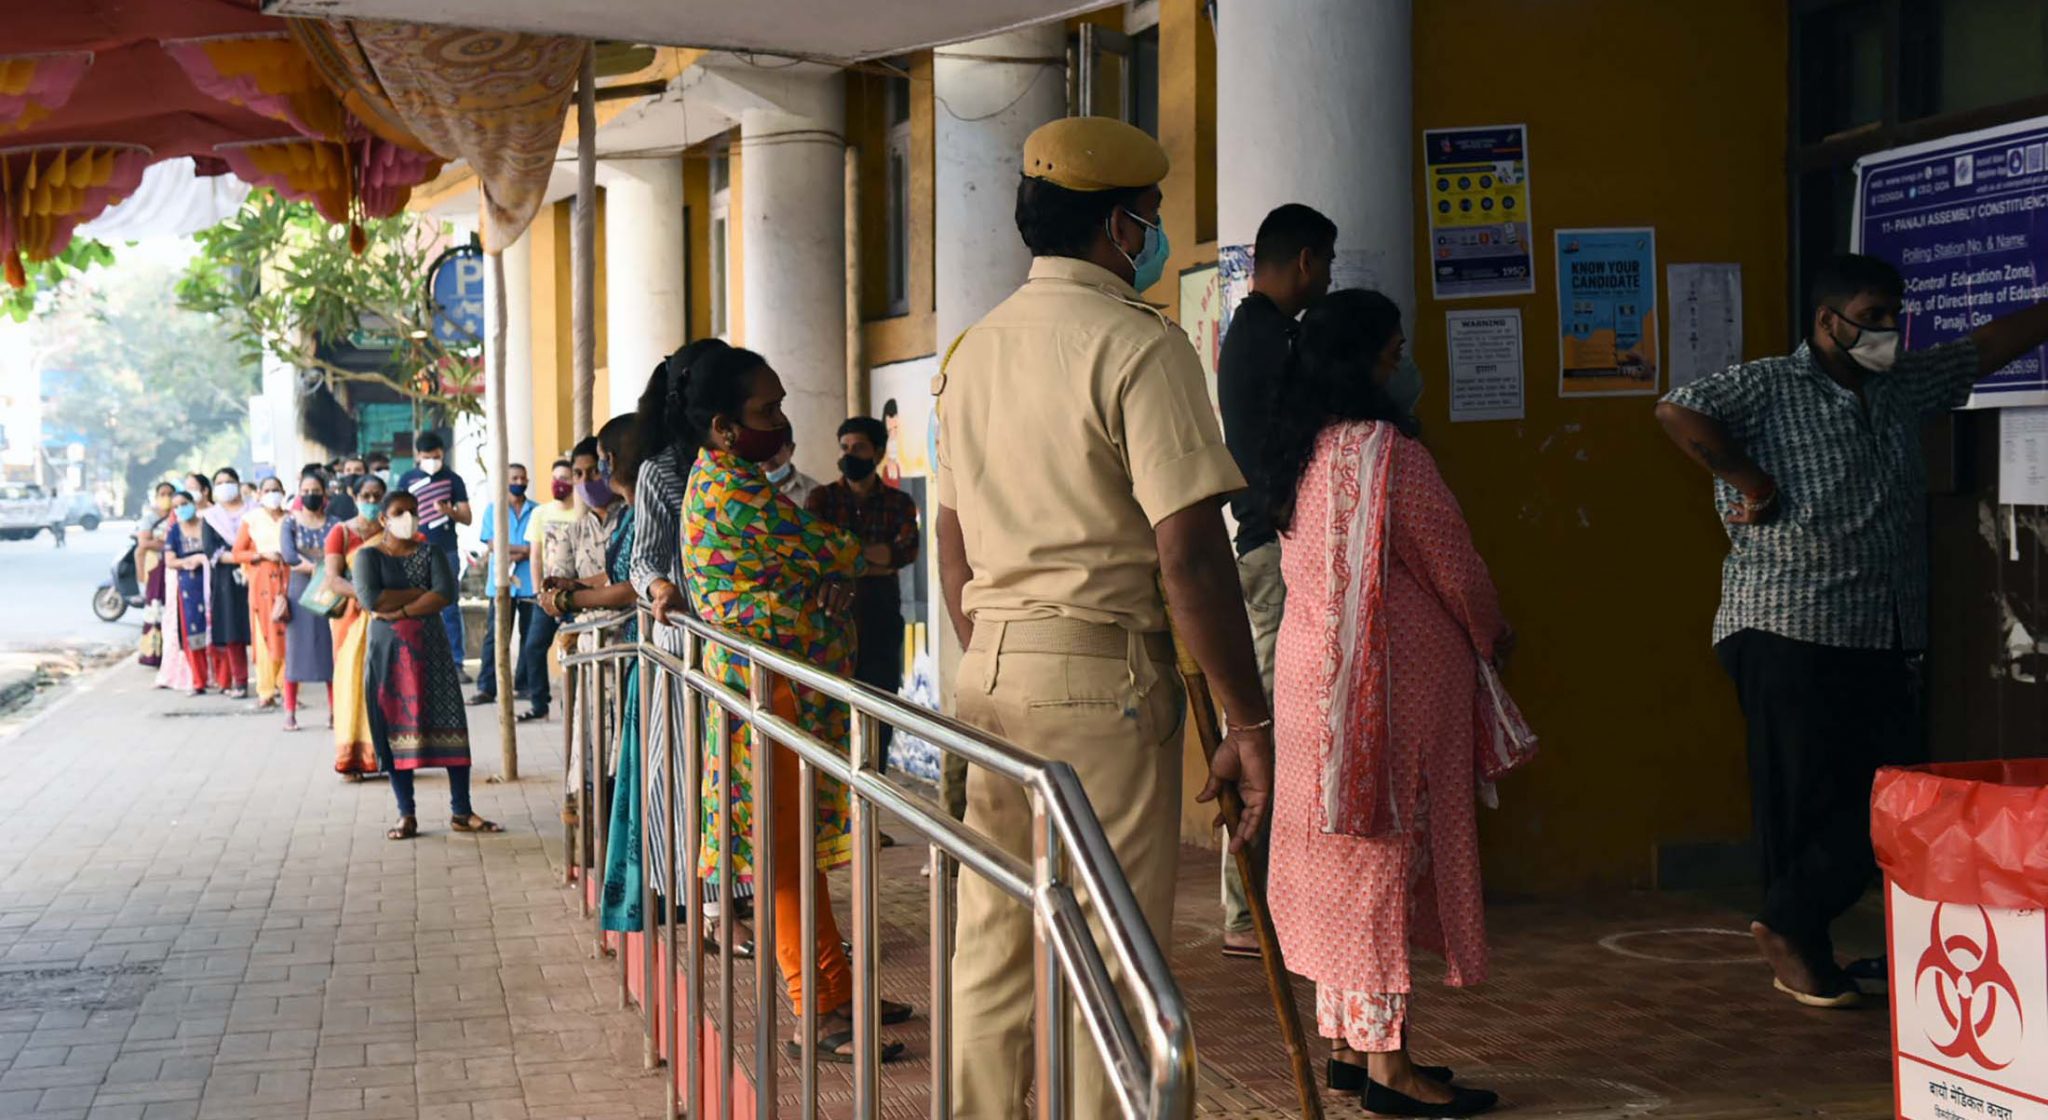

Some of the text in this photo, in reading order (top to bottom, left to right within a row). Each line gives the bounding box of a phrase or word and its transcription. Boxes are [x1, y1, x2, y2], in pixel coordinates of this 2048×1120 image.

[1895, 214, 1926, 231] PANAJI
[1927, 206, 1977, 226] ASSEMBLY
[1902, 247, 1932, 263] Polling
[1934, 242, 1966, 259] Station
[1986, 235, 1995, 250] &
[456, 258, 483, 296] P
[1571, 260, 1640, 274] KNOW YOUR
[1950, 267, 2002, 287] Education
[1572, 274, 1641, 289] CANDIDATE
[1925, 295, 1936, 311] of
[1937, 290, 1994, 310] Directorate
[1996, 286, 2007, 303] of
[1461, 318, 1506, 328] WARNING
[1934, 311, 1993, 332] Panaji, Goa
[1929, 1081, 1948, 1100] बायो
[1950, 1084, 1985, 1113] मेडिकल
[1986, 1102, 2013, 1120] कचरा
